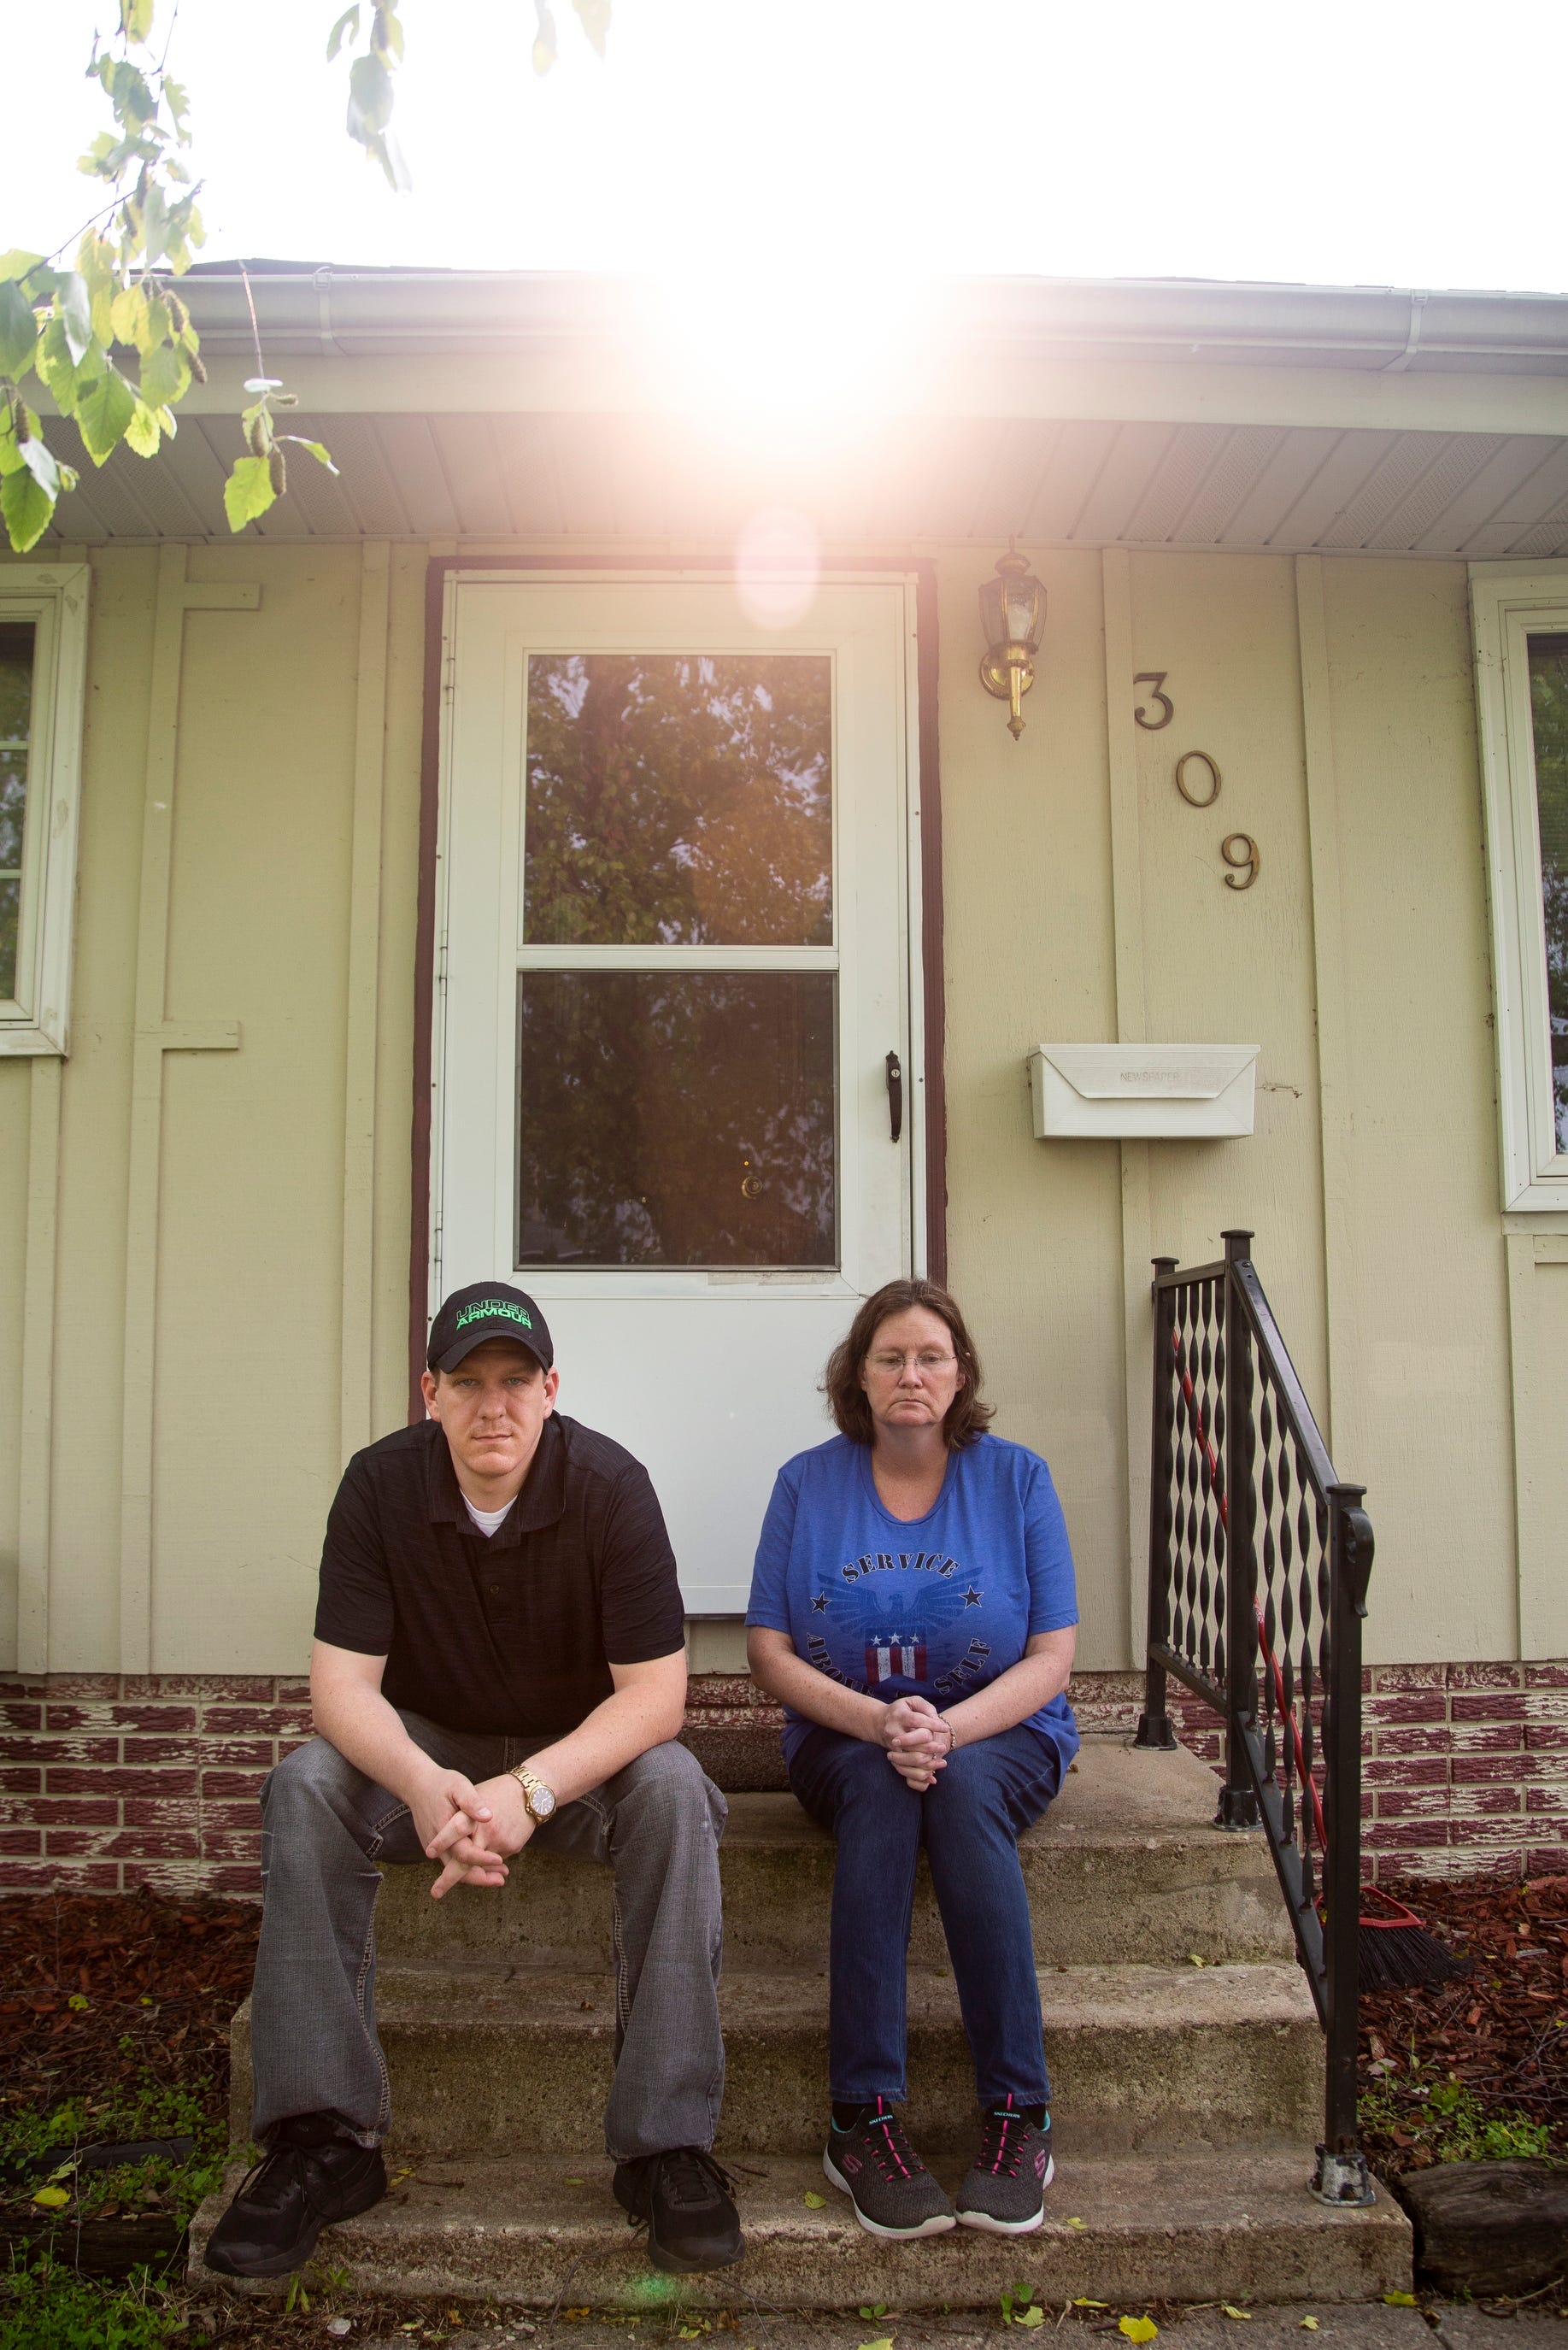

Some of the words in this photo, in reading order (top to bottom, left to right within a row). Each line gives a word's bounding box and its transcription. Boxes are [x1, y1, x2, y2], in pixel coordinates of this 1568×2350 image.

[455, 1299, 530, 1321] UNDER
[455, 1308, 532, 1331] ARMOUR
[841, 1551, 960, 1583] SERVICE
[933, 1637, 992, 1695] SELF
[868, 2114, 894, 2125] SKECHERS
[994, 2111, 1021, 2119] SKECHERS
